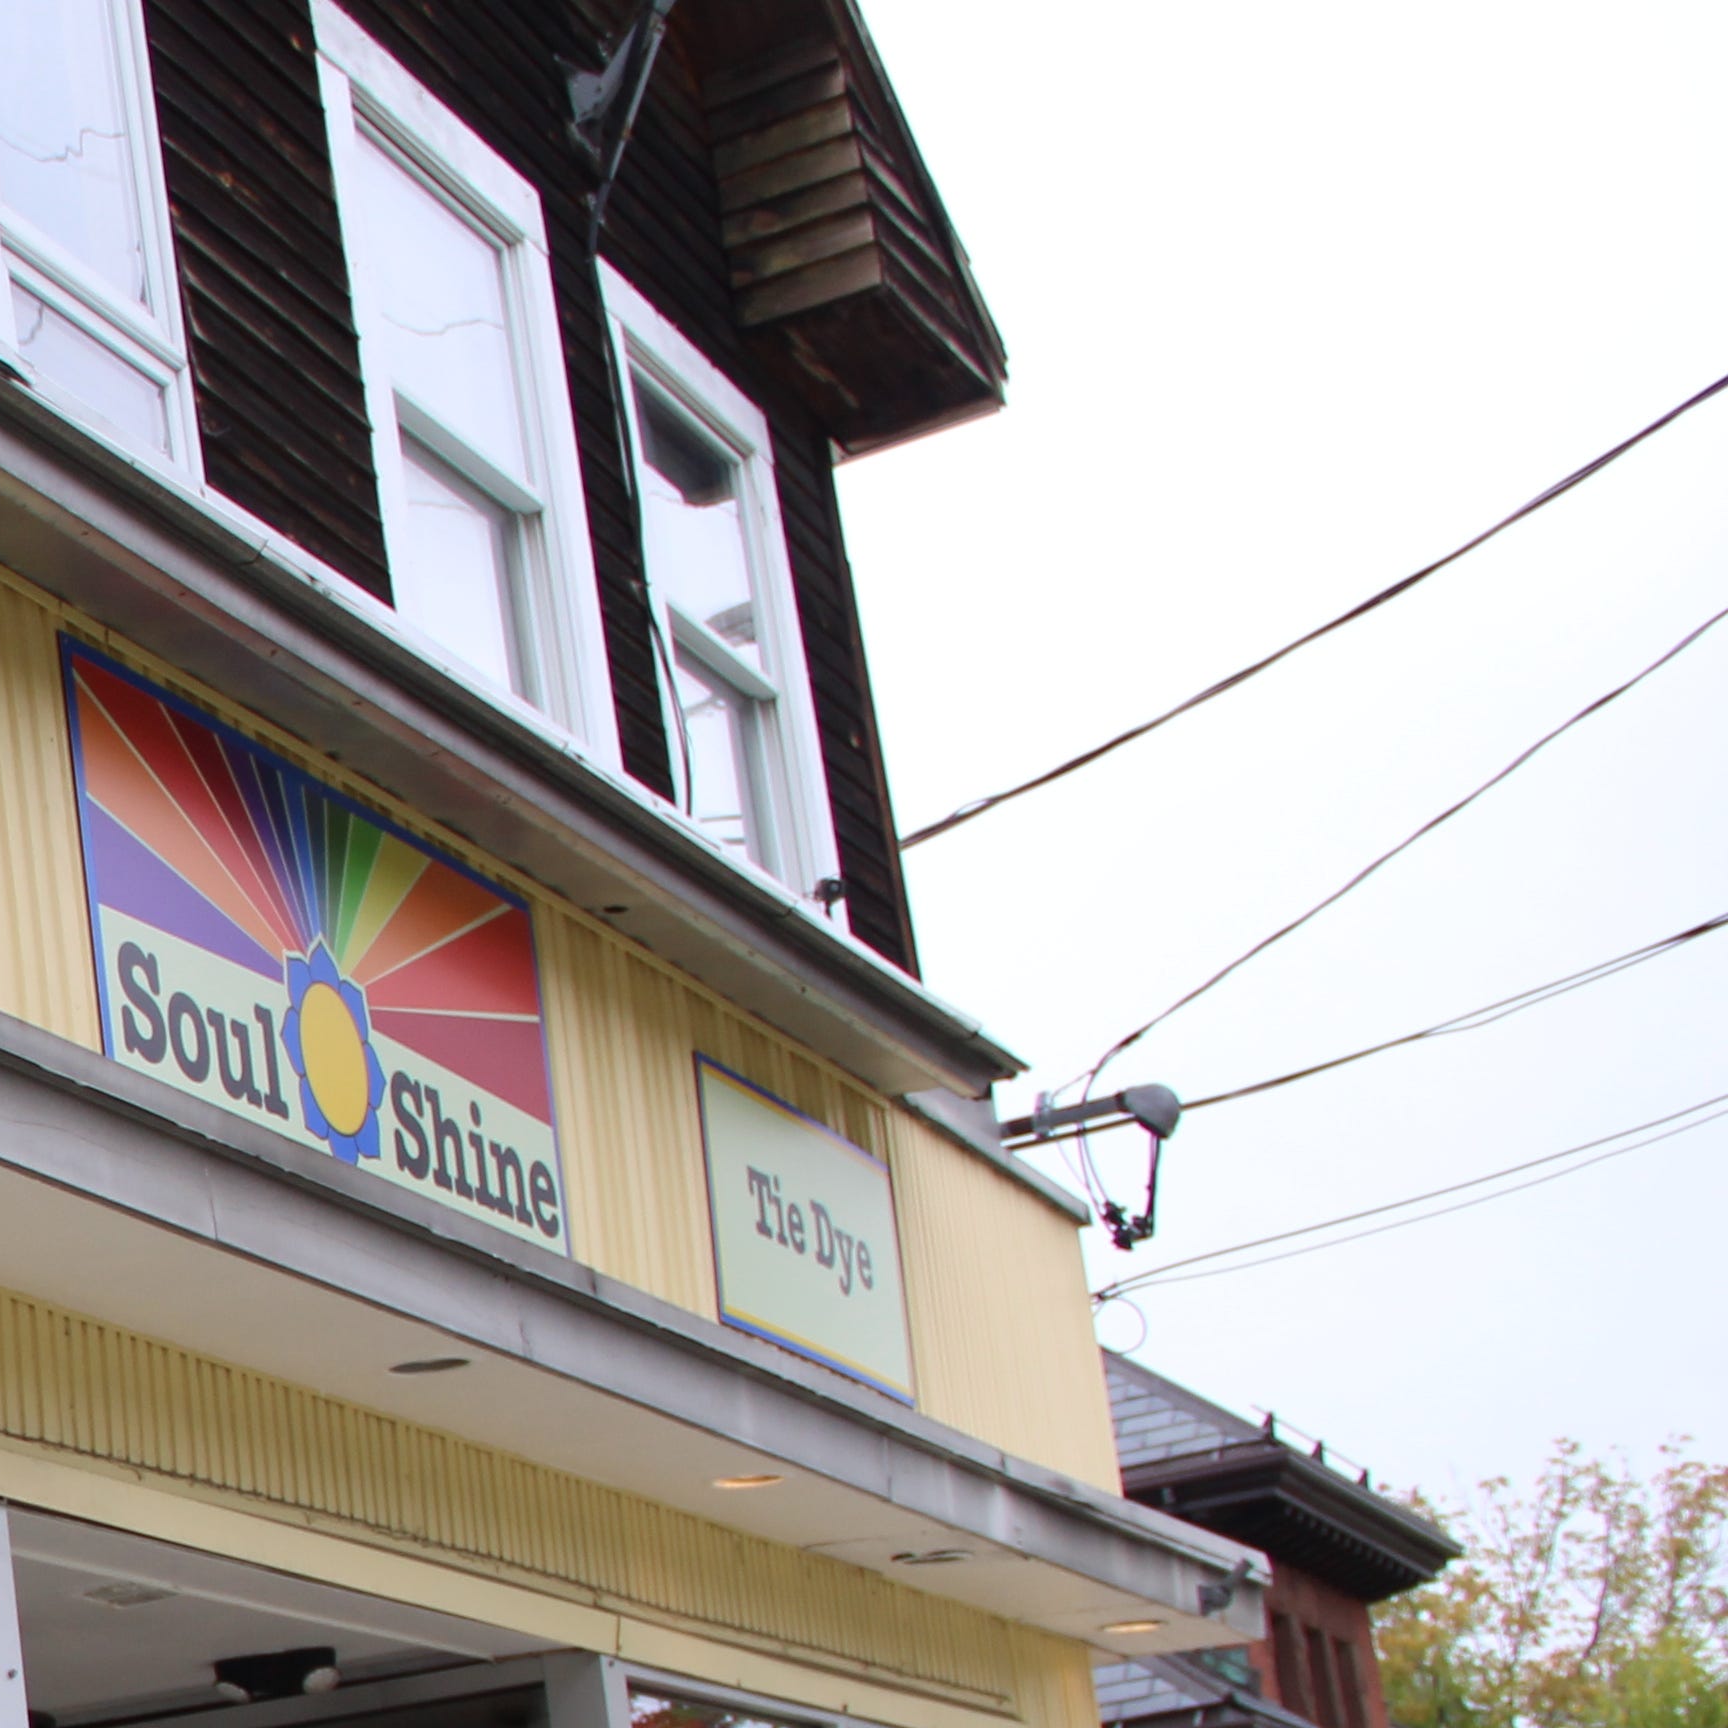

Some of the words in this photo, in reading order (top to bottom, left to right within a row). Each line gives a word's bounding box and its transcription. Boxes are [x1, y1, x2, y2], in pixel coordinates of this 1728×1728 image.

[116, 940, 288, 1120] Soul
[389, 1068, 560, 1237] Shine
[746, 1164, 806, 1255] Tie
[809, 1199, 873, 1297] Dye
